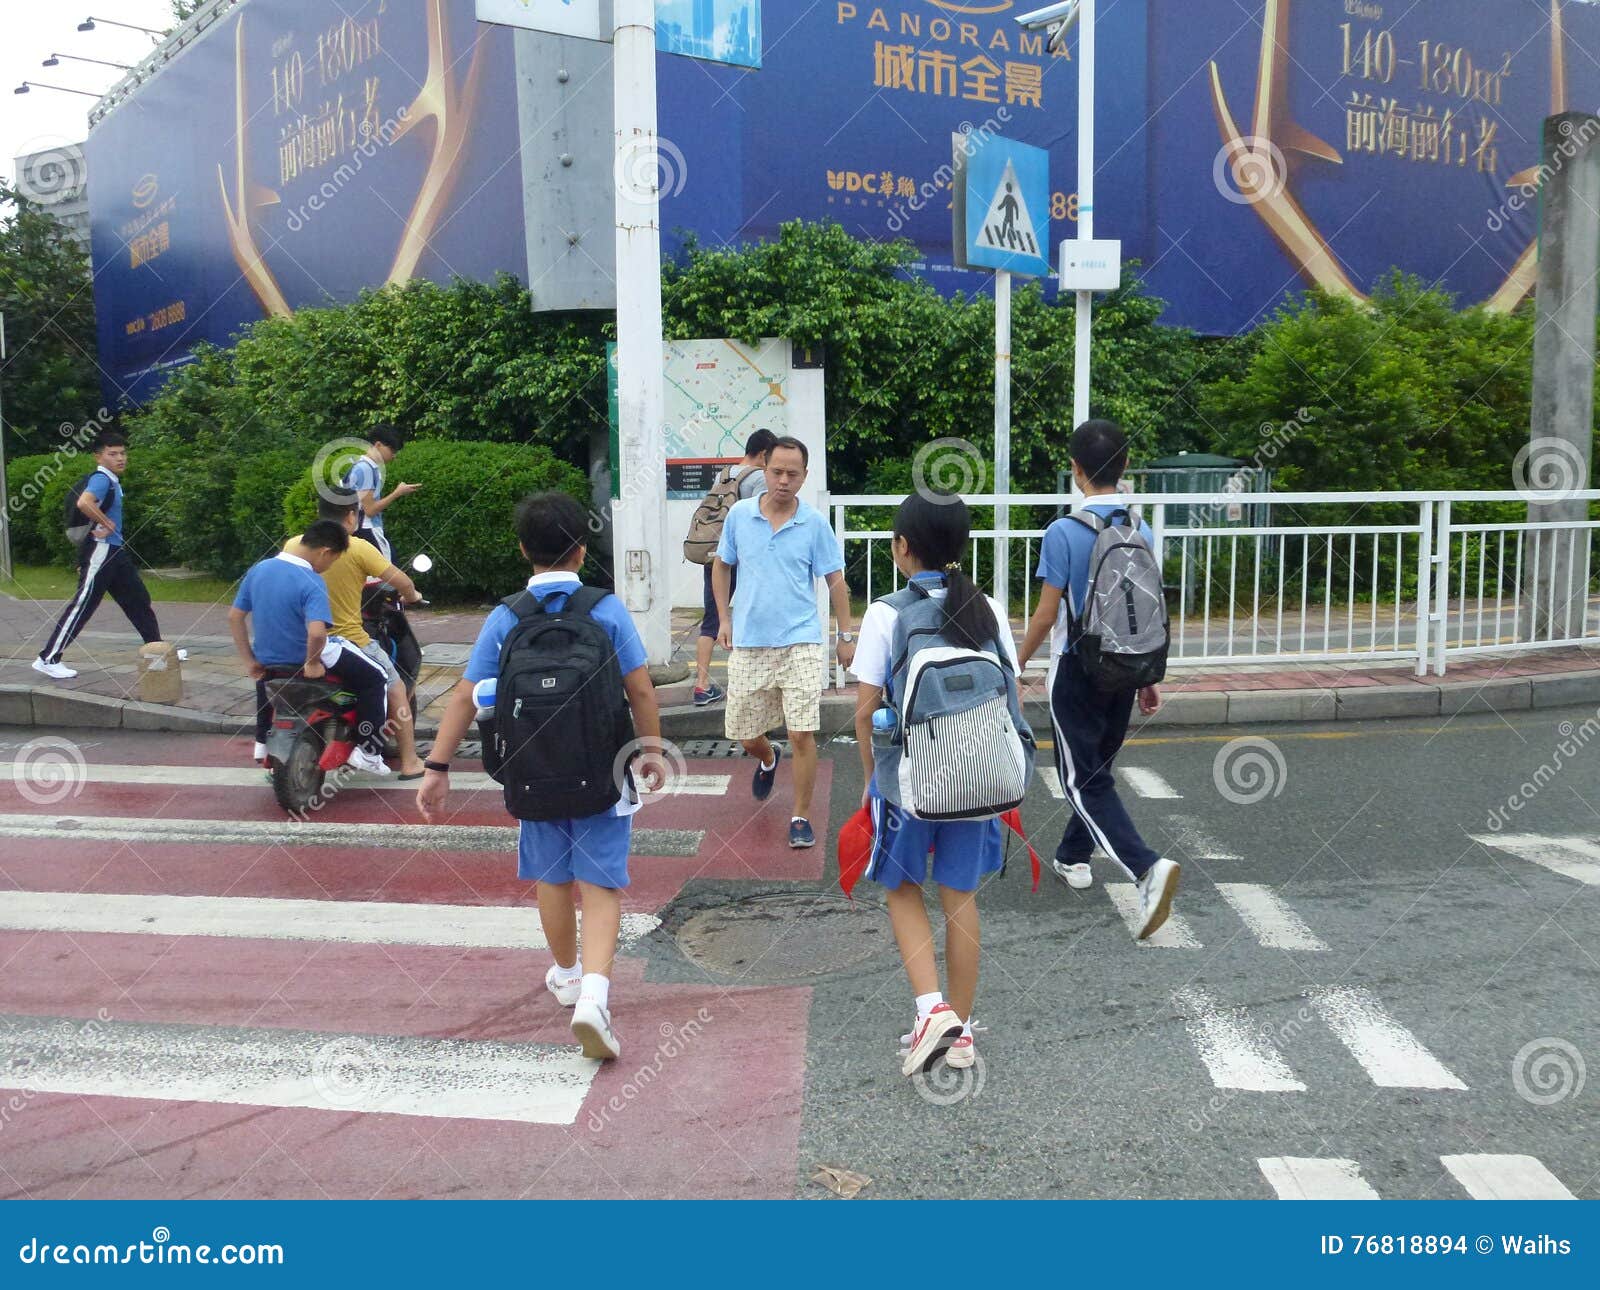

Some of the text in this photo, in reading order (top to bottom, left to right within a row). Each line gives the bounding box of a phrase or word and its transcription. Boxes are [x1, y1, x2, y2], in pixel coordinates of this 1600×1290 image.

[837, 1, 1072, 61] PANORAMA
[873, 40, 1043, 109] 城市全景
[1345, 91, 1499, 175] 前海前行者
